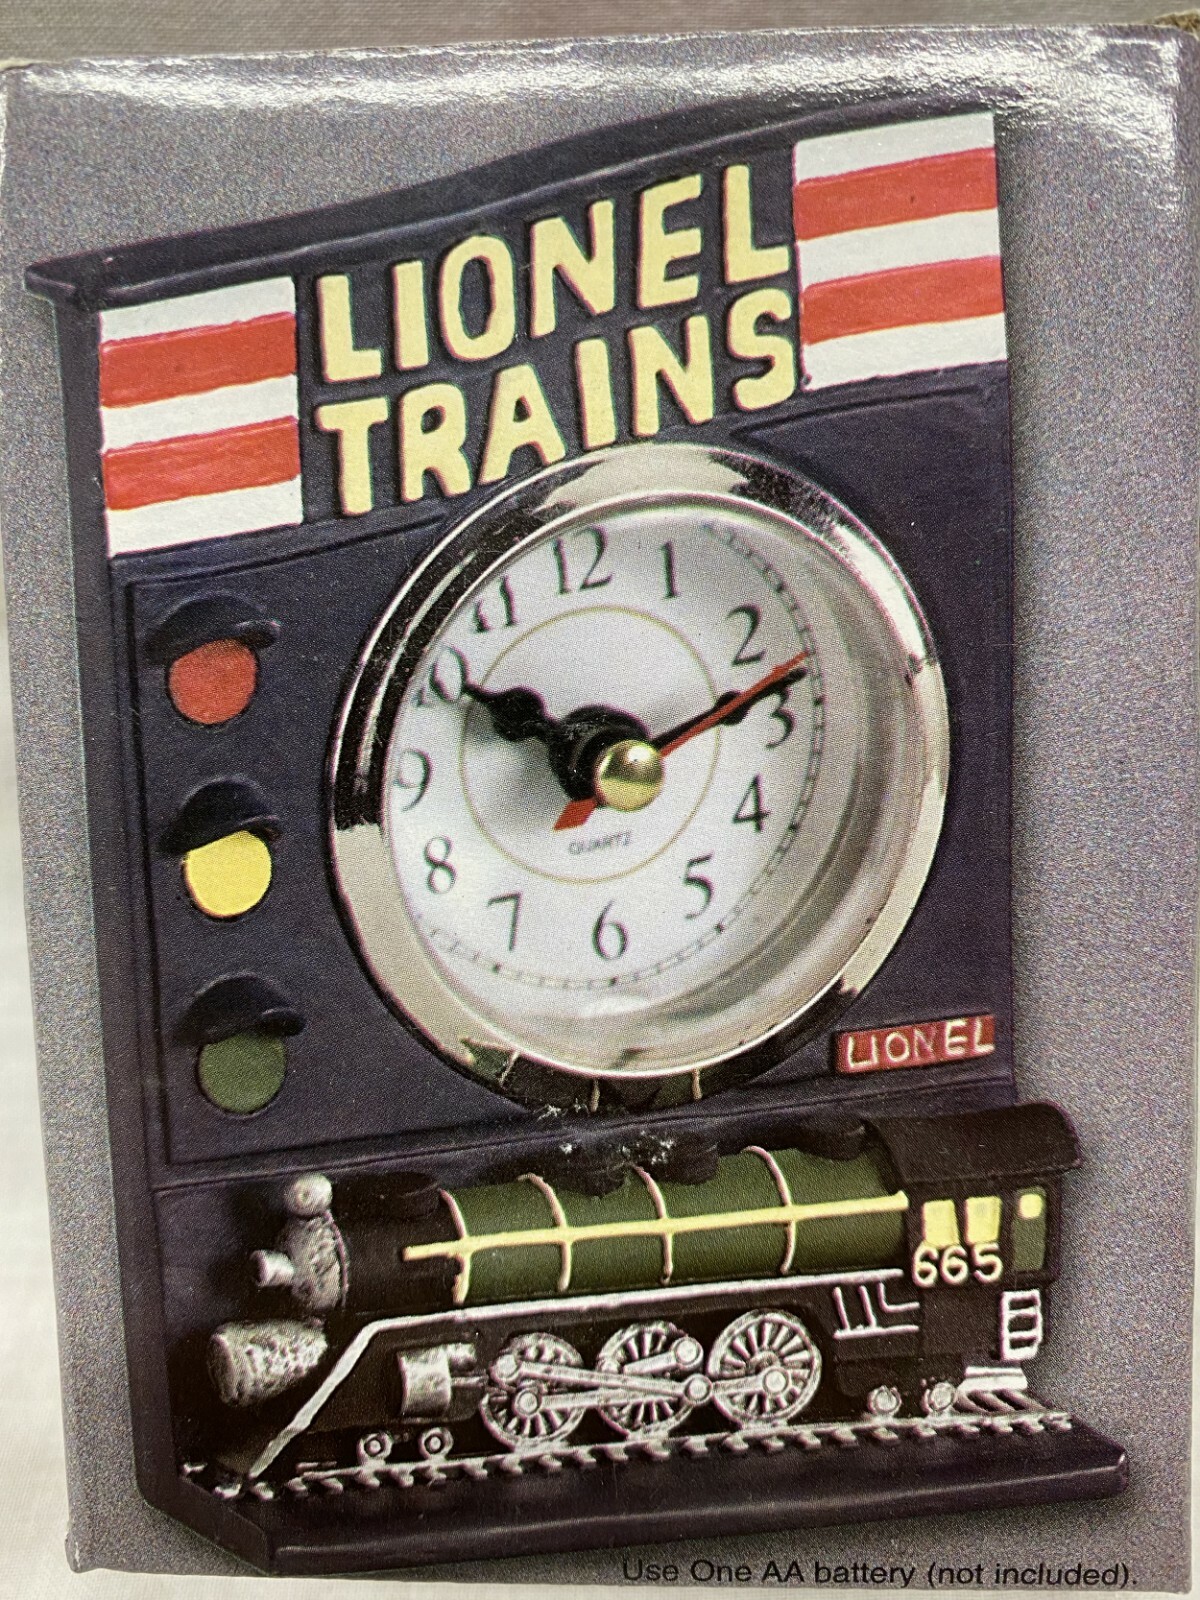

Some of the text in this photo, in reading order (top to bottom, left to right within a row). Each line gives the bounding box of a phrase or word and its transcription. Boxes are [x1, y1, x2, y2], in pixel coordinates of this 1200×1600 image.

[317, 164, 791, 383] LIONEL
[314, 288, 797, 516] TRAINS
[553, 526, 613, 595] 12
[659, 540, 680, 599] 1
[726, 604, 768, 666] 2
[394, 749, 433, 812] 9
[732, 774, 770, 834] 4
[423, 836, 457, 894] 8
[684, 853, 715, 920] 5
[487, 891, 522, 952] 7
[591, 900, 628, 961] 6
[845, 1017, 996, 1070] LIONEL
[911, 1241, 1003, 1288] 665
[622, 1557, 1138, 1590] Use One AA battery (not included).
